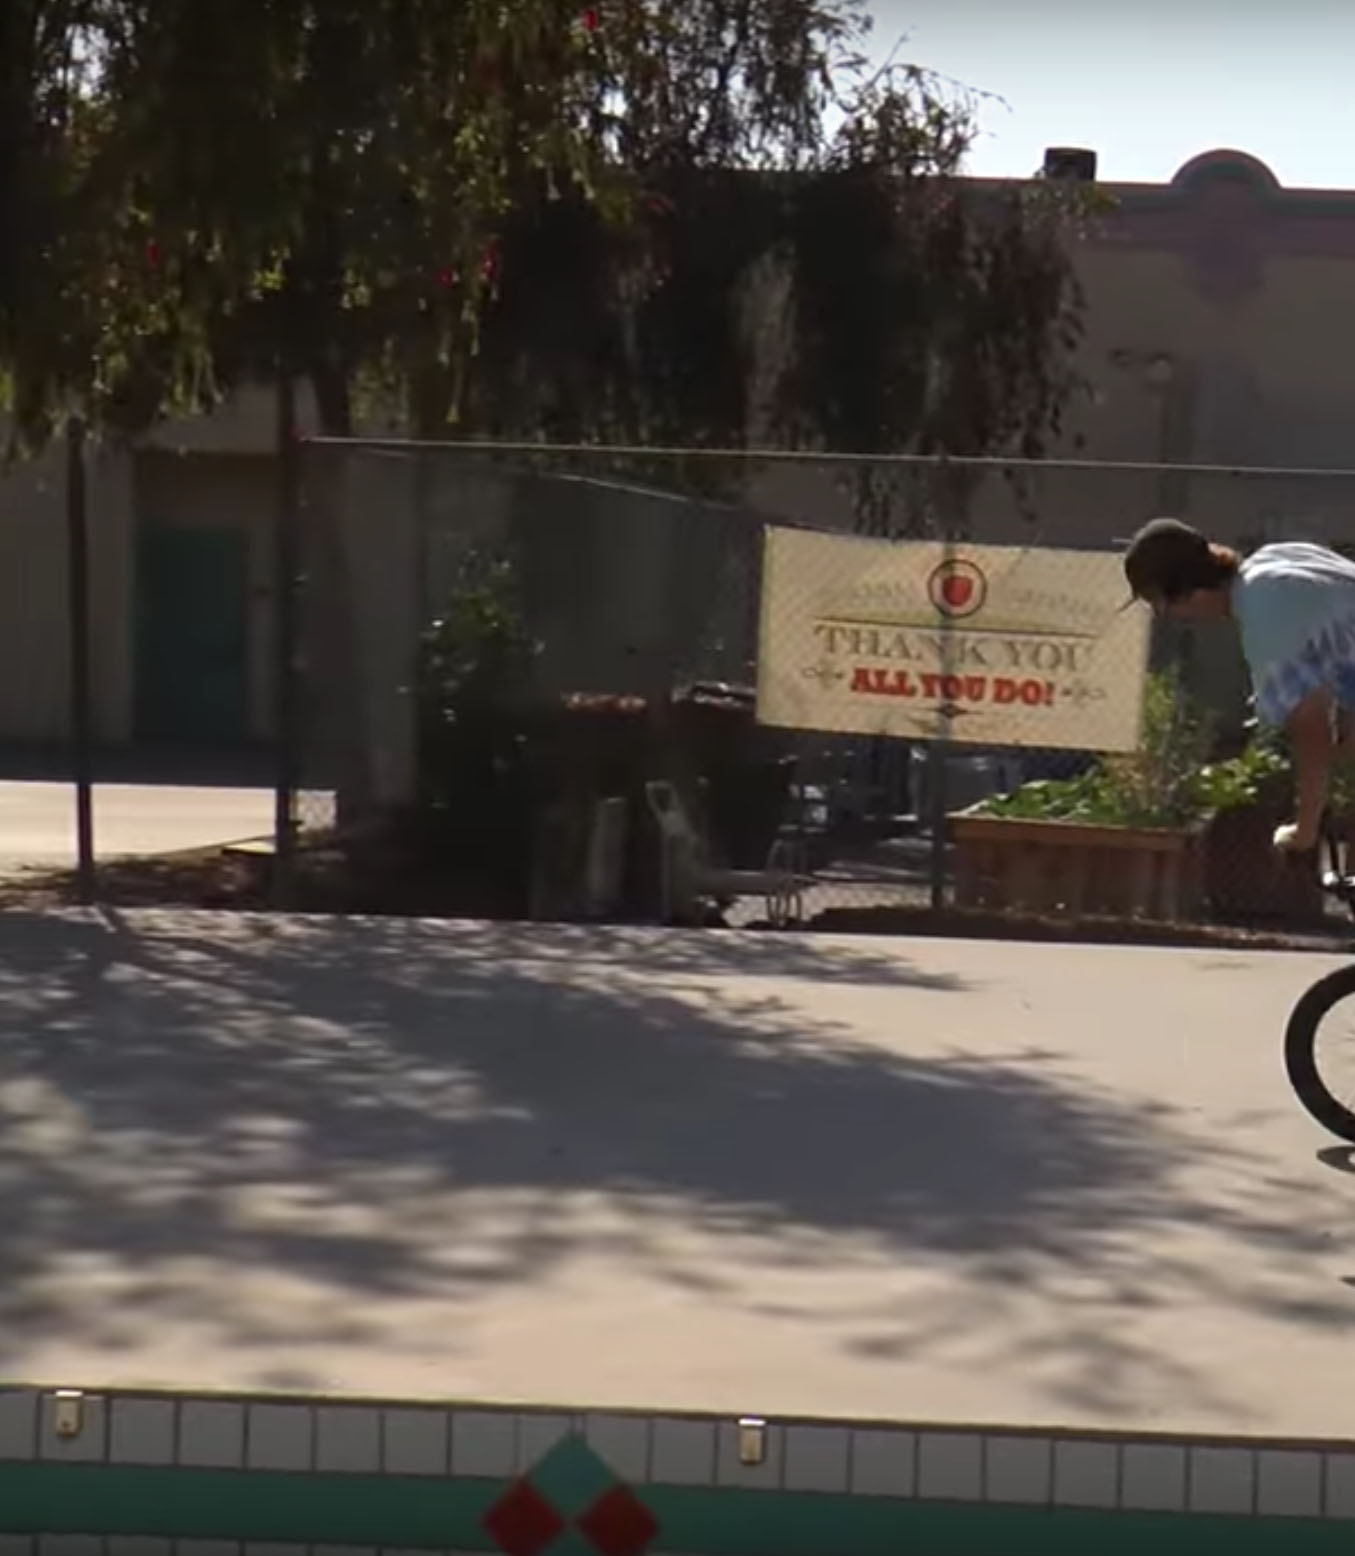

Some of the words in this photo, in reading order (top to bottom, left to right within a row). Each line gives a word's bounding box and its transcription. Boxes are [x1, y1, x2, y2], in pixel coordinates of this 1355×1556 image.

[813, 624, 987, 665] THANK
[1001, 638, 1094, 671] YOU
[850, 668, 917, 697] ALL
[919, 673, 986, 701] YOU
[993, 678, 1054, 706] DO!
